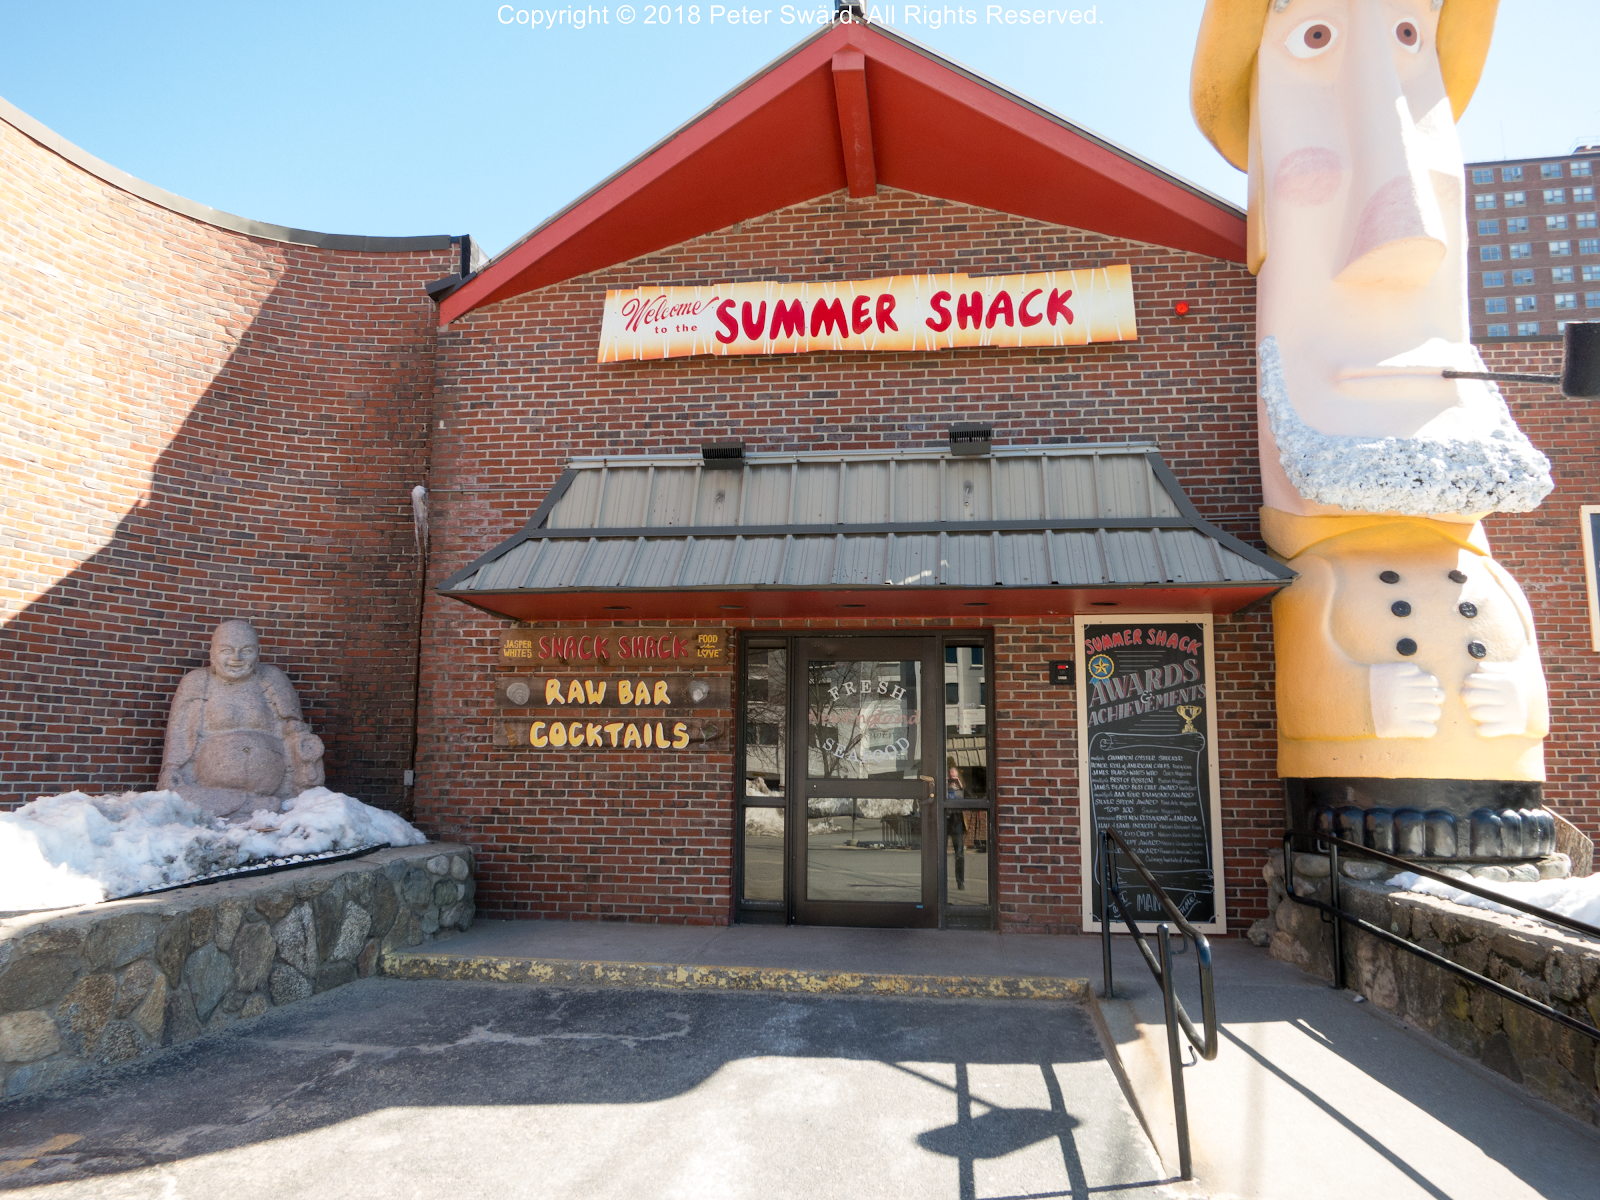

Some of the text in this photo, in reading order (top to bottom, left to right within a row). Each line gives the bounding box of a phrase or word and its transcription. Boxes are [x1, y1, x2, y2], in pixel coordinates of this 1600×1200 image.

[622, 295, 719, 332] Welcome
[715, 288, 1074, 344] SUMMER SHACK
[655, 324, 697, 334] to the
[503, 640, 532, 649] JASPER
[539, 635, 688, 660] SNACK SHACK
[698, 634, 718, 643] FOOD
[1085, 628, 1202, 655] SUMMER SHACK
[545, 678, 671, 706] RAW BAR
[827, 680, 906, 701] FRESH
[1088, 658, 1200, 708] AWARDS
[1087, 683, 1206, 728] ACHIEVEMENTS
[1140, 690, 1153, 704] &
[529, 721, 690, 748] COCKTAILS
[822, 737, 910, 763] SEAFOOD
[1136, 893, 1162, 912] MAN
